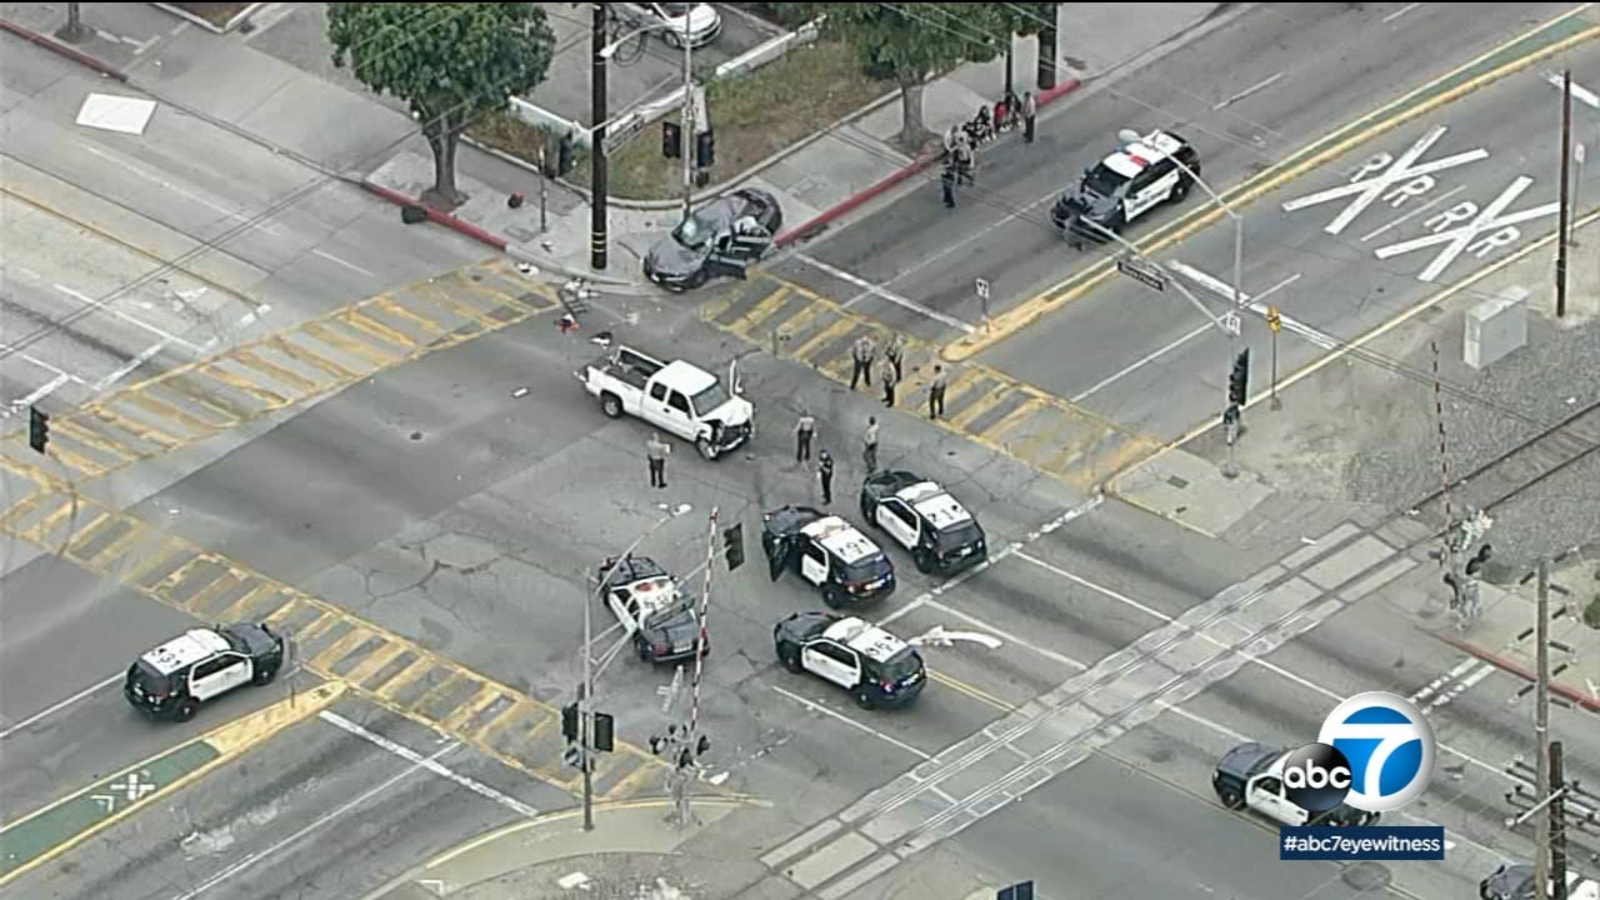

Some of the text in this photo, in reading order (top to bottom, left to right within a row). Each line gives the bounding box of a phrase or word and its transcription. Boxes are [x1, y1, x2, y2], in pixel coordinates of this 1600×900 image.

[1382, 175, 1435, 208] R
[1423, 201, 1478, 232] R
[1466, 226, 1521, 258] R
